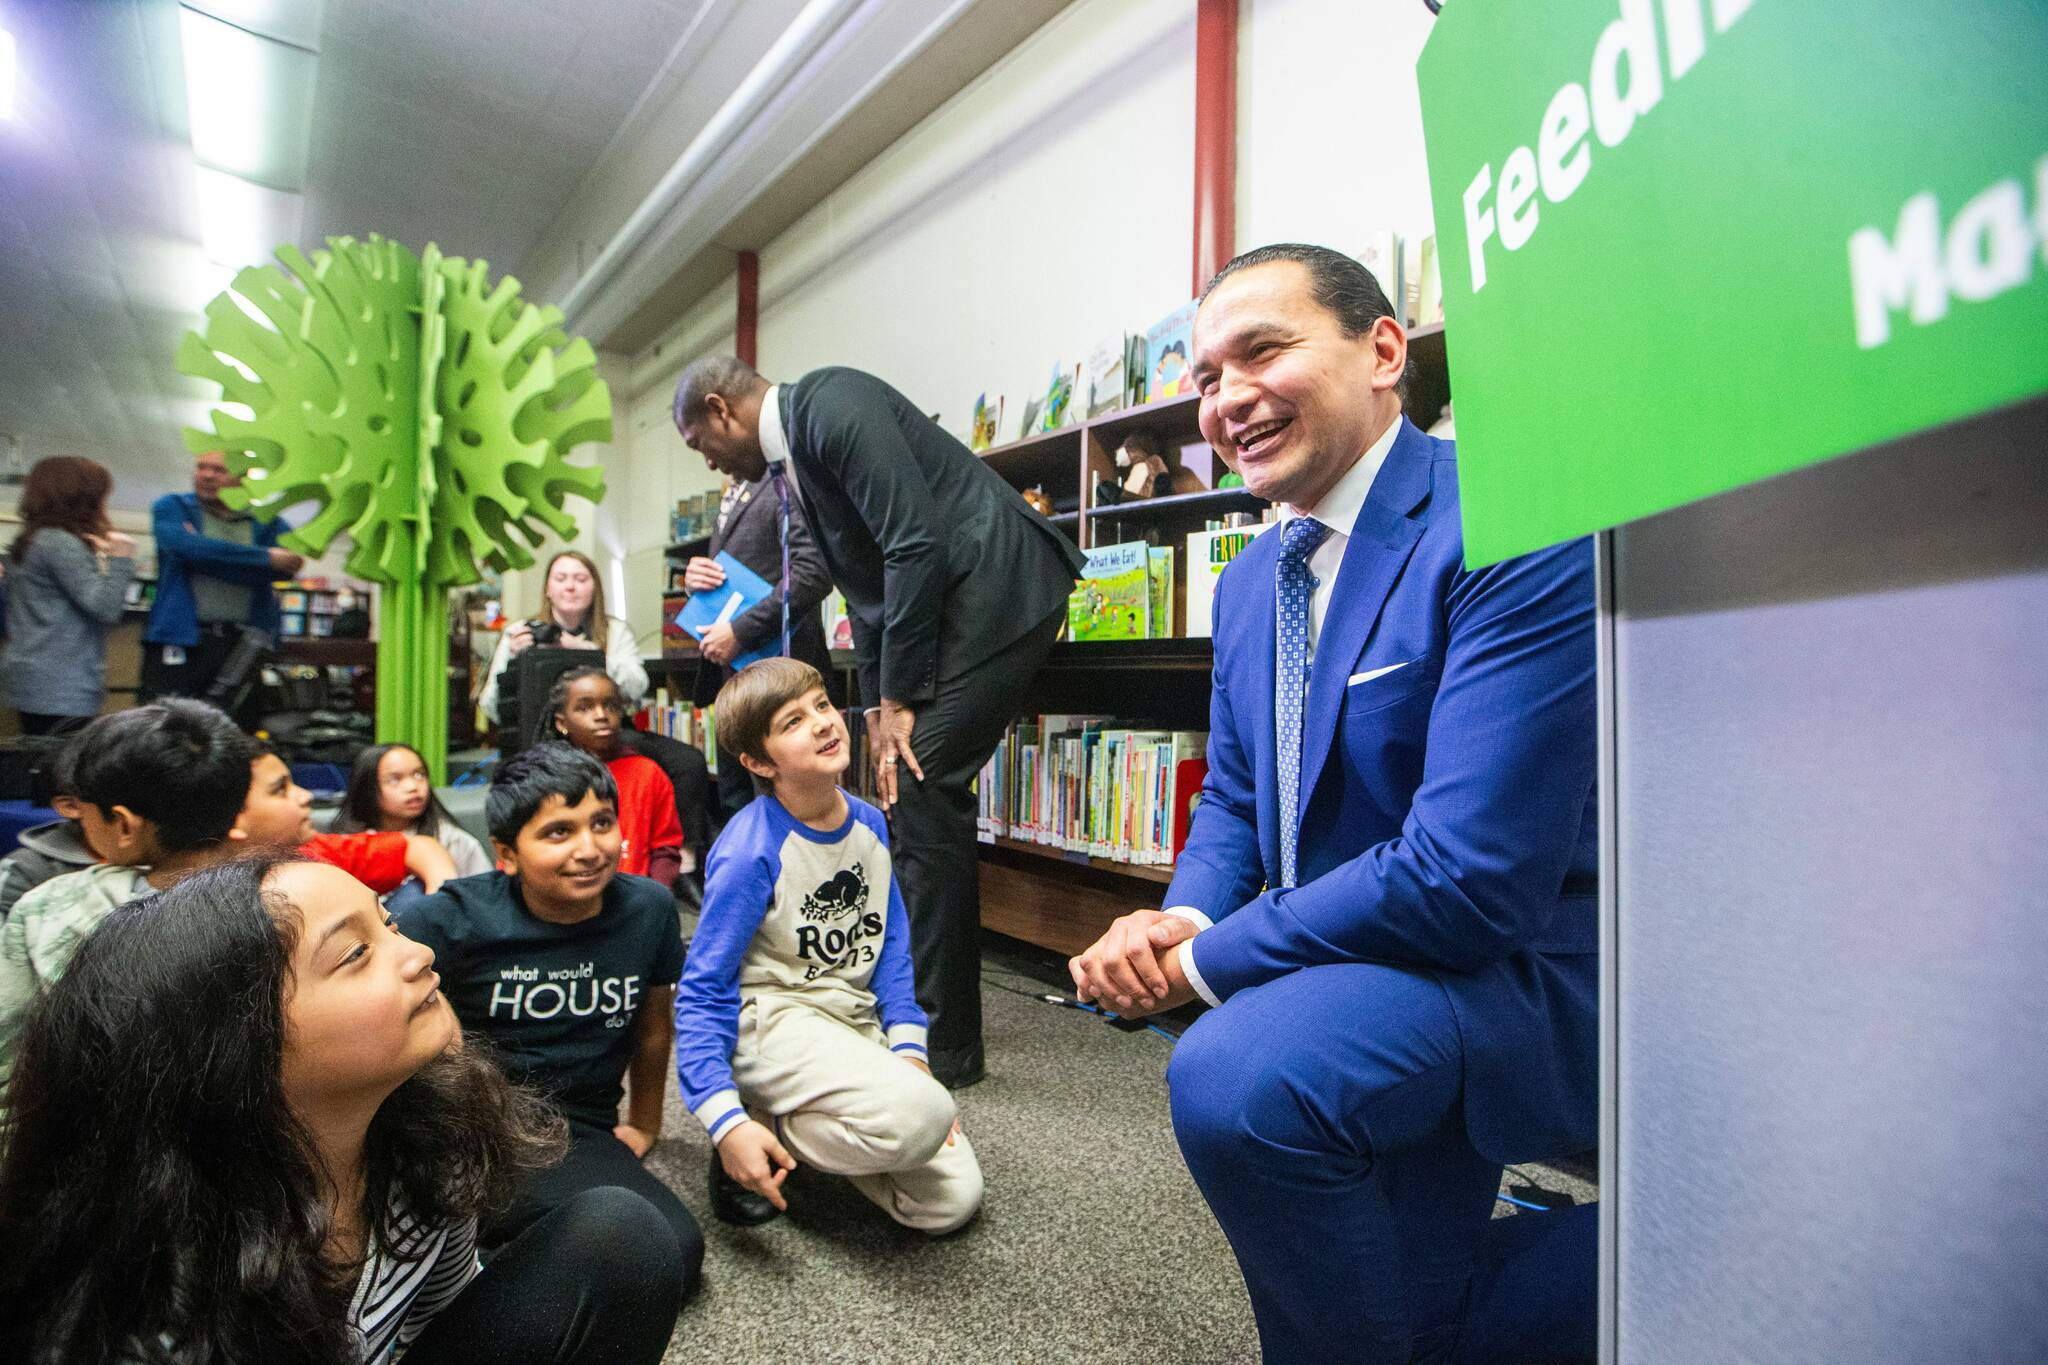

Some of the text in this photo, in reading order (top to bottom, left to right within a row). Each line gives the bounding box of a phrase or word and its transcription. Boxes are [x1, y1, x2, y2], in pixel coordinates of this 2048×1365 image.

[1110, 551, 1120, 565] We
[500, 962, 594, 981] what would
[489, 975, 640, 1020] HOUSE
